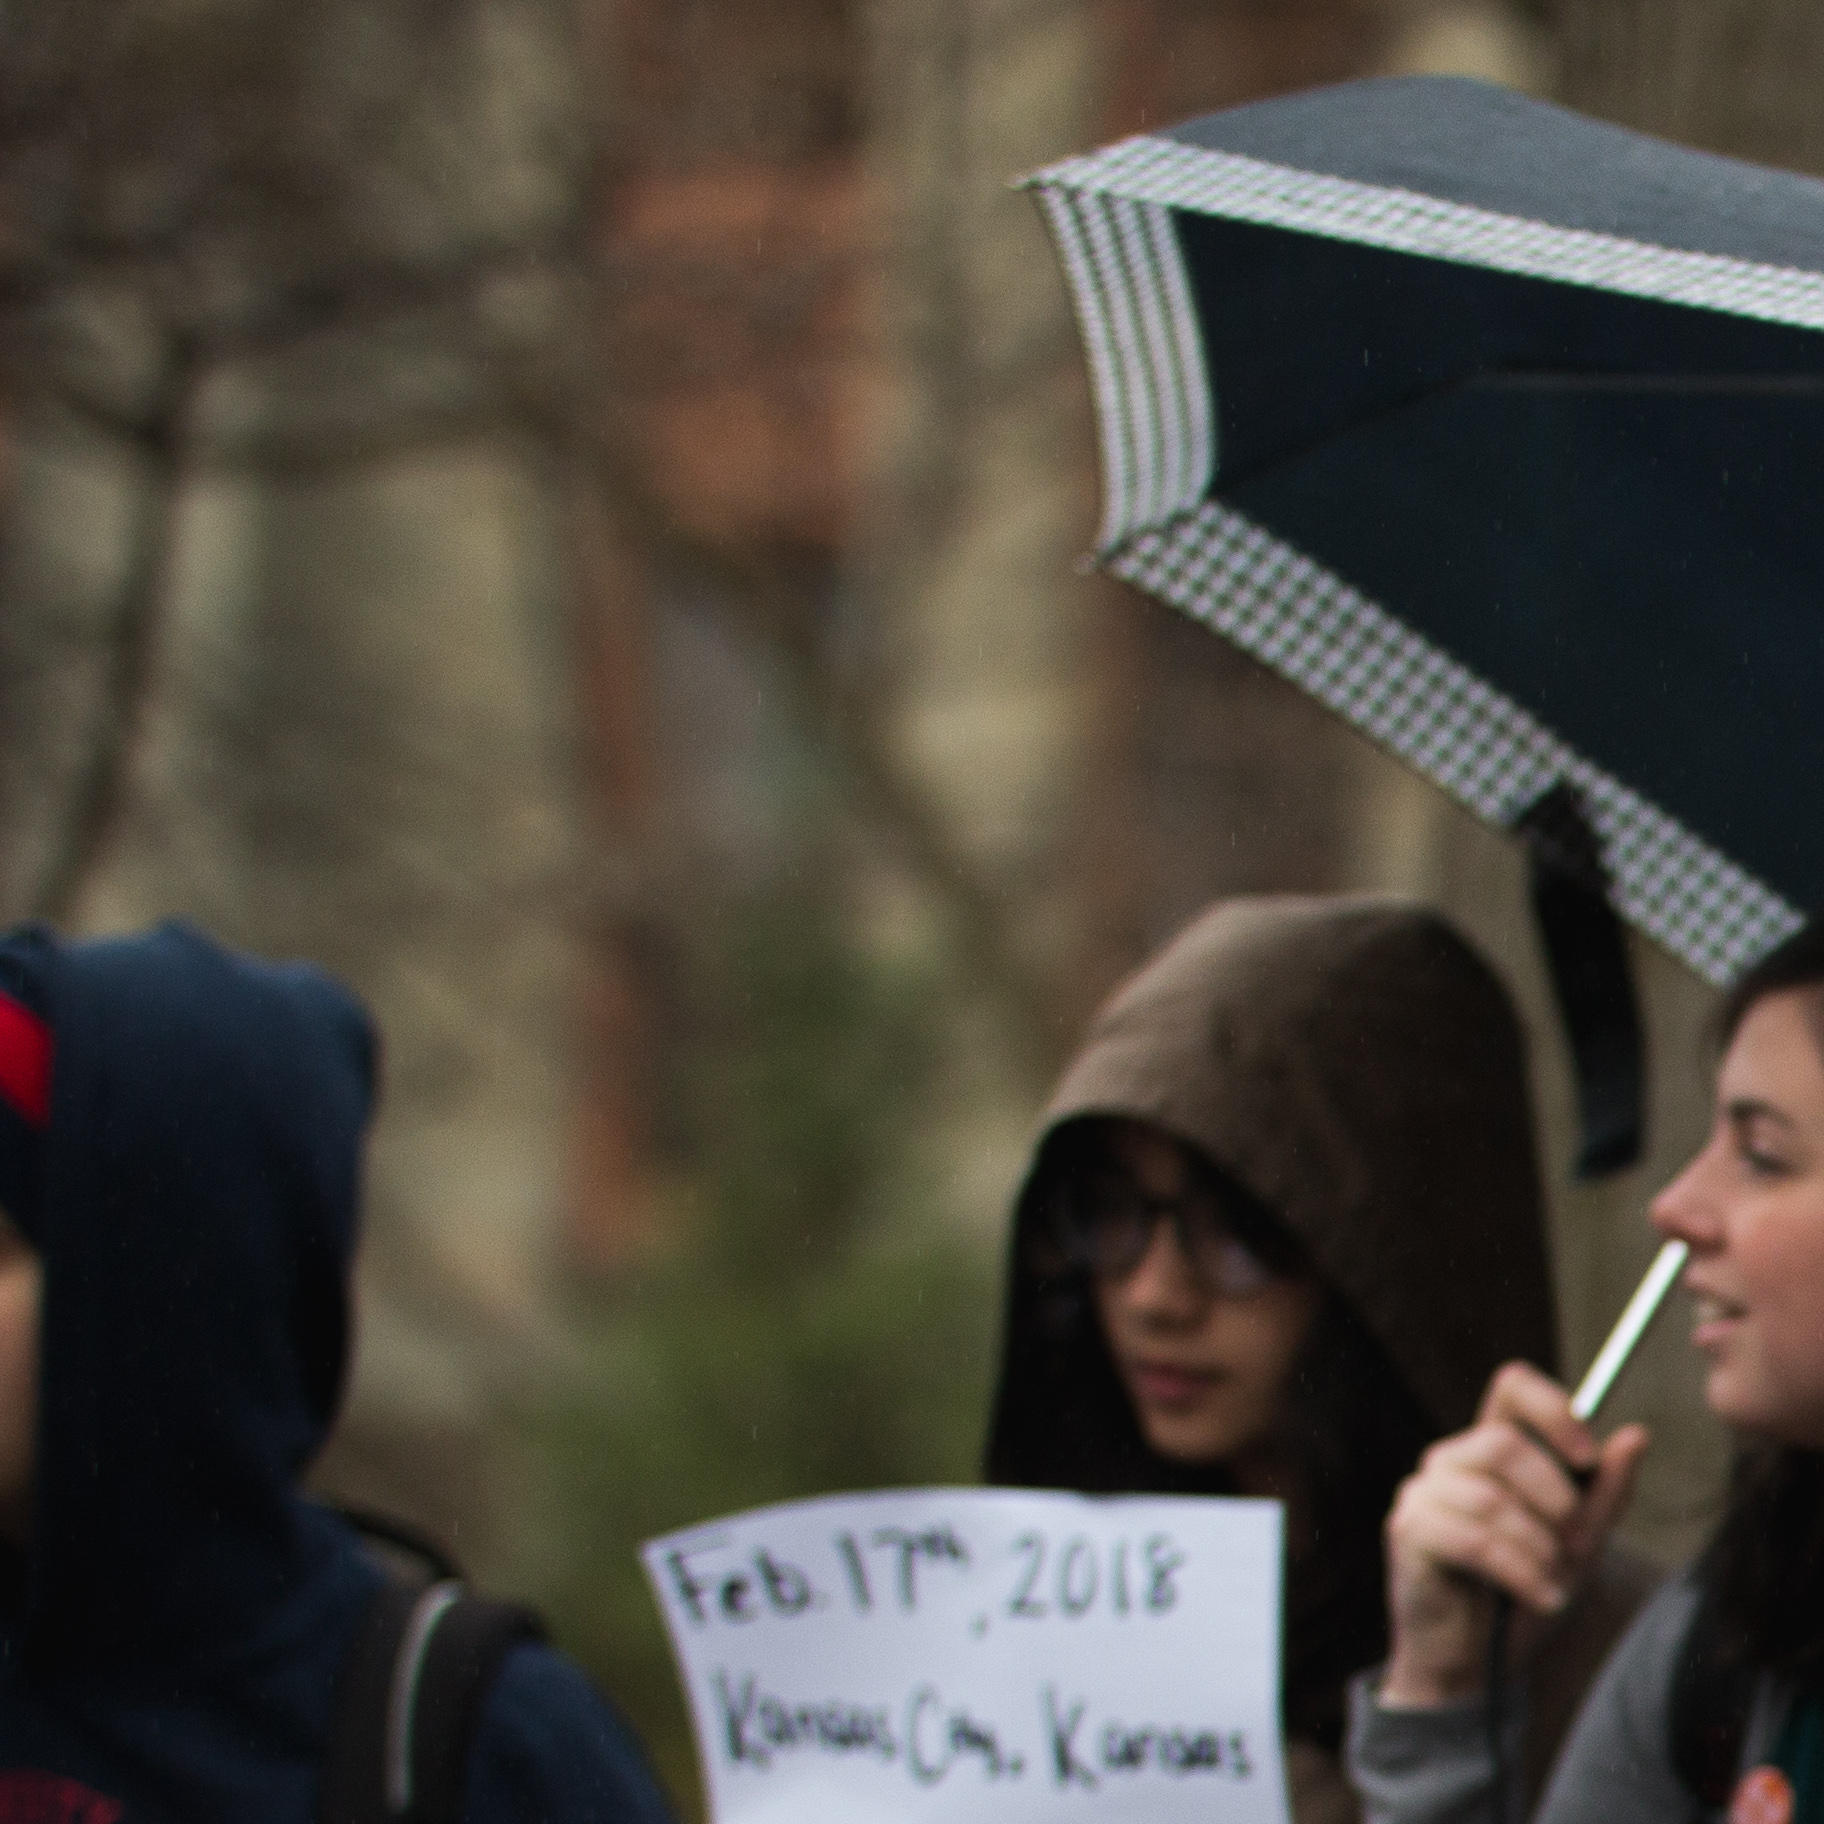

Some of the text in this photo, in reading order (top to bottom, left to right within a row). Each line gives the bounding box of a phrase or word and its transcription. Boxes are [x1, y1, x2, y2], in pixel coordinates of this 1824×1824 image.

[1006, 1530, 1188, 1618] 2018
[710, 1666, 898, 1771] Kansas
[1040, 1683, 1252, 1790] Kansas
